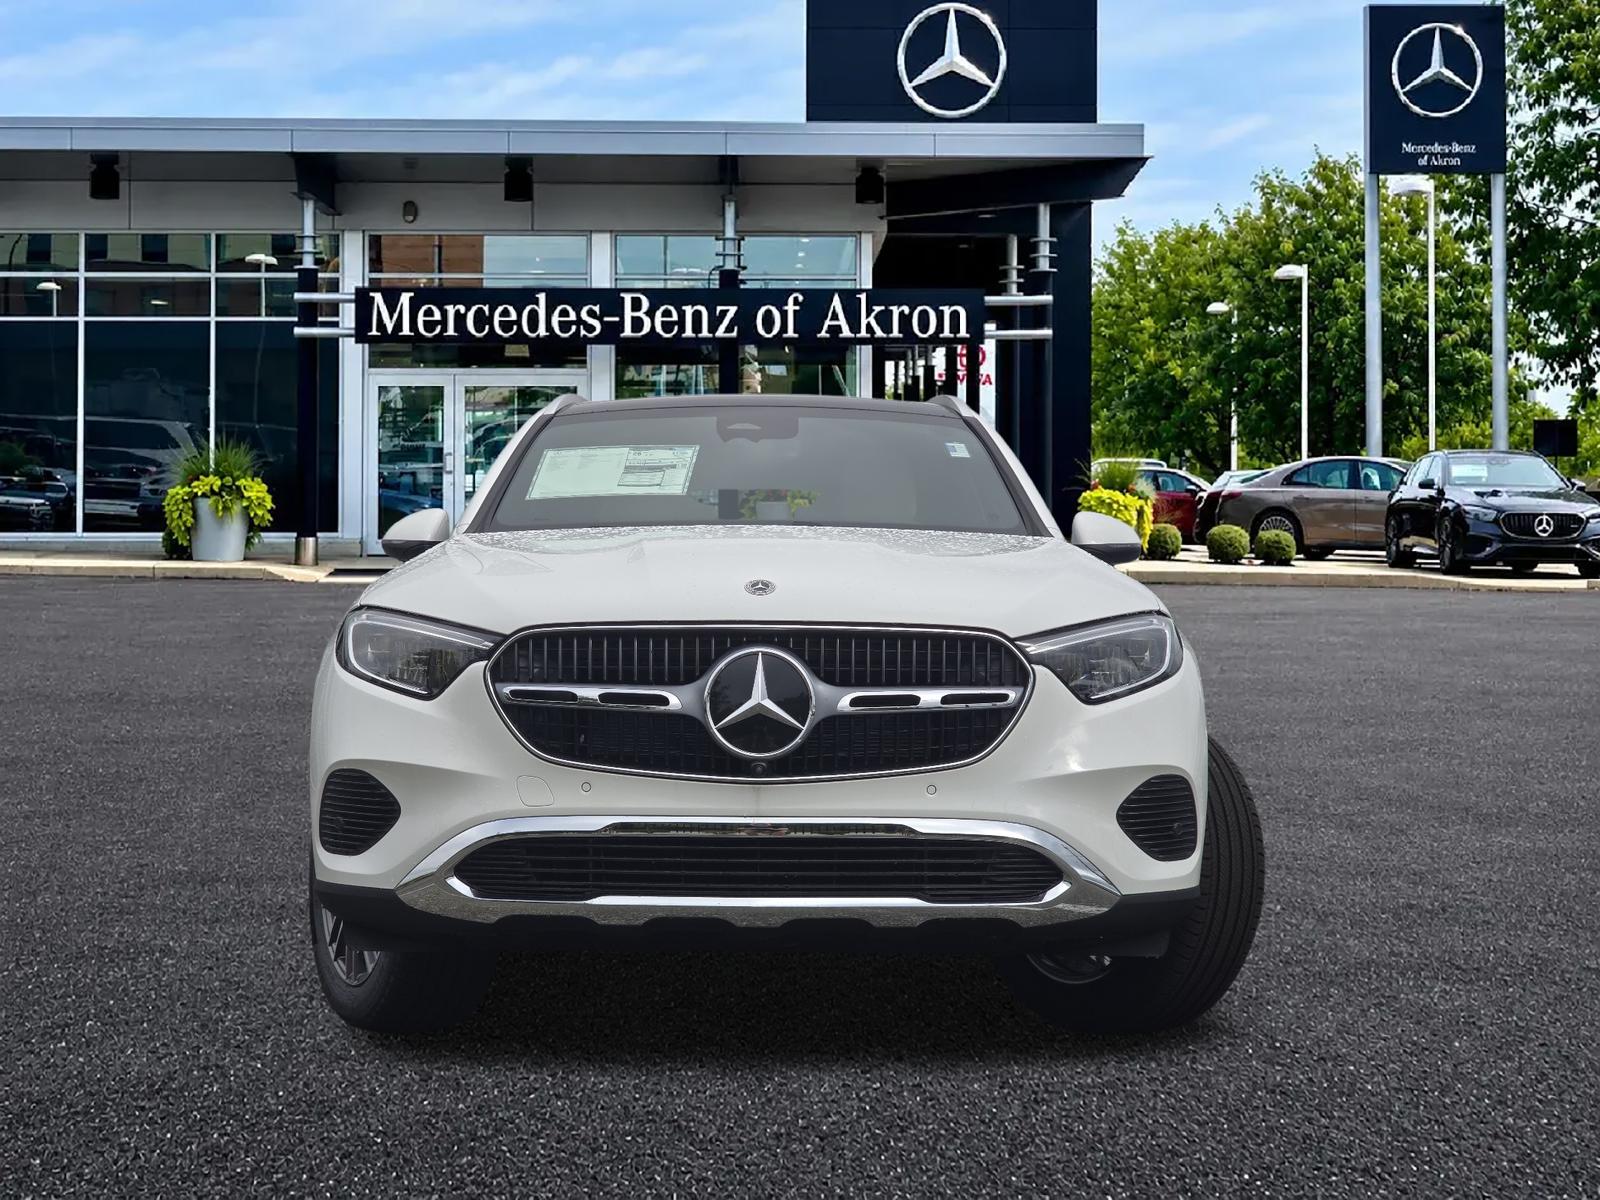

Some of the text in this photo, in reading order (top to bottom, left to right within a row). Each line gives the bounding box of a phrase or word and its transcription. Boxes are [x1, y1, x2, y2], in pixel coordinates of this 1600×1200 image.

[1401, 142, 1477, 154] Mercedes-Benz
[1417, 154, 1461, 166] of Akron
[367, 292, 971, 338] Mercedes-Benz of Akron
